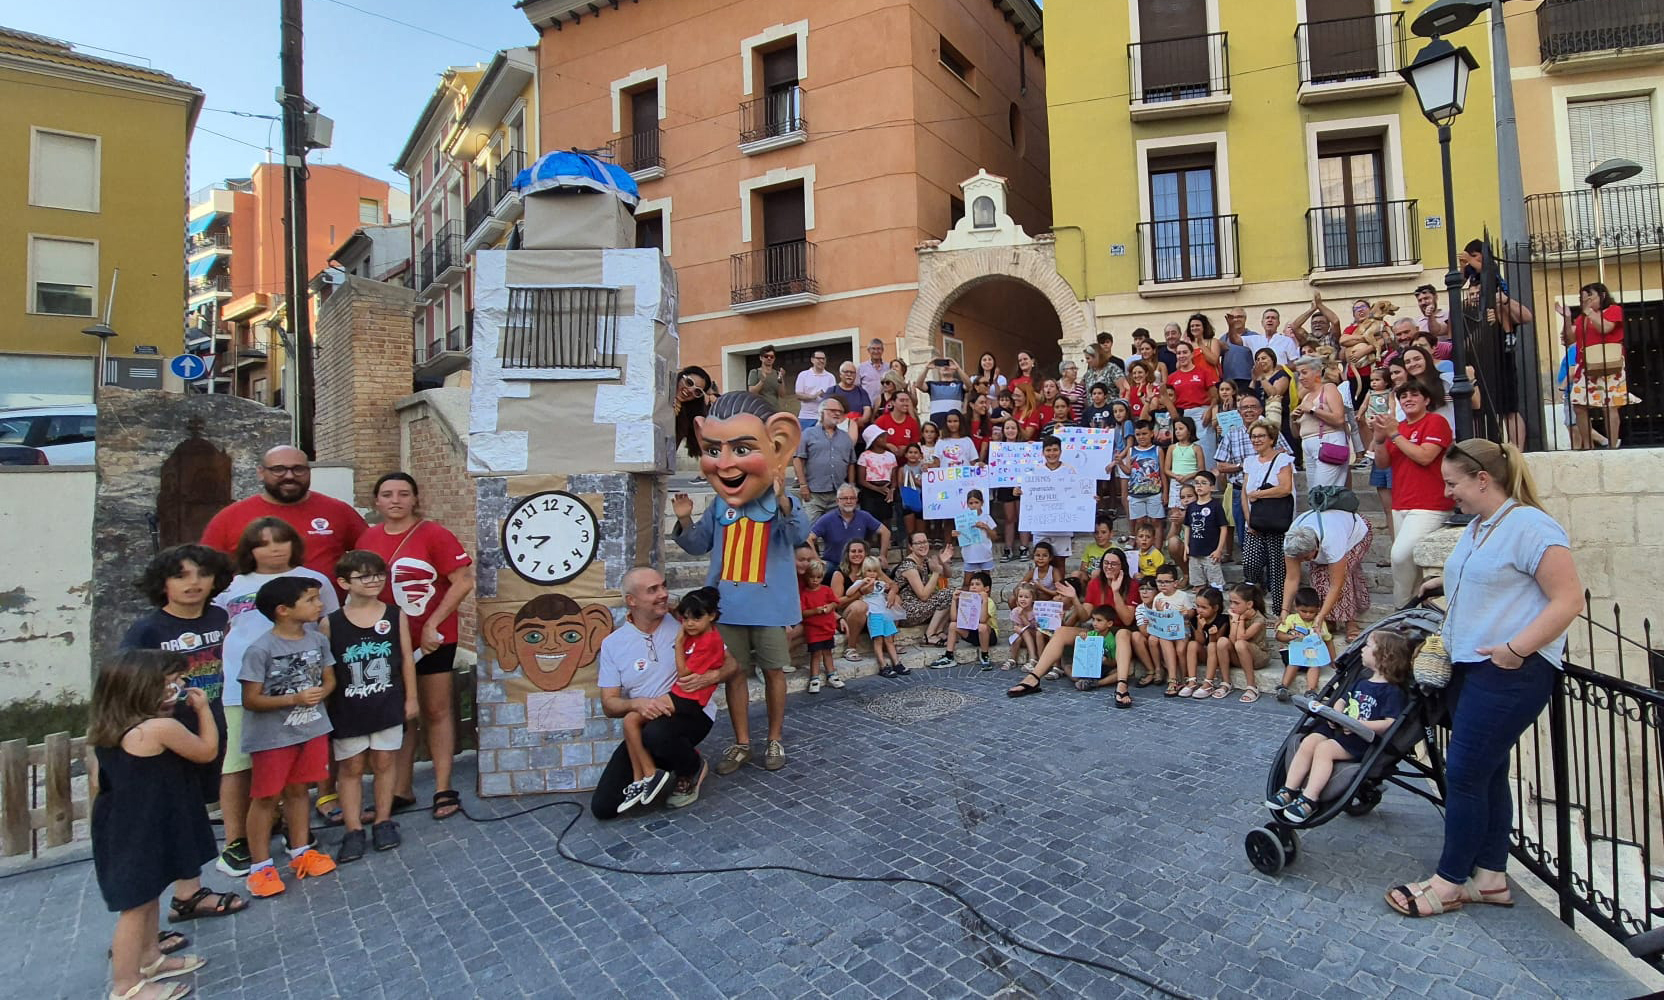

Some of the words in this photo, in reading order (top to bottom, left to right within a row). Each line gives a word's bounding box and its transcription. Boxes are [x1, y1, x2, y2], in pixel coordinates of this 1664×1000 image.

[522, 503, 538, 519] 11
[542, 499, 559, 511] 12
[563, 505, 574, 516] 1
[512, 518, 523, 530] 10
[575, 514, 586, 525] 2
[511, 534, 518, 544] 9
[580, 530, 589, 543] 3
[517, 553, 525, 562] 8
[571, 548, 583, 558] 4
[531, 560, 541, 573] 7
[547, 564, 555, 575] 6
[563, 559, 571, 571] 5
[347, 657, 392, 688] 14
